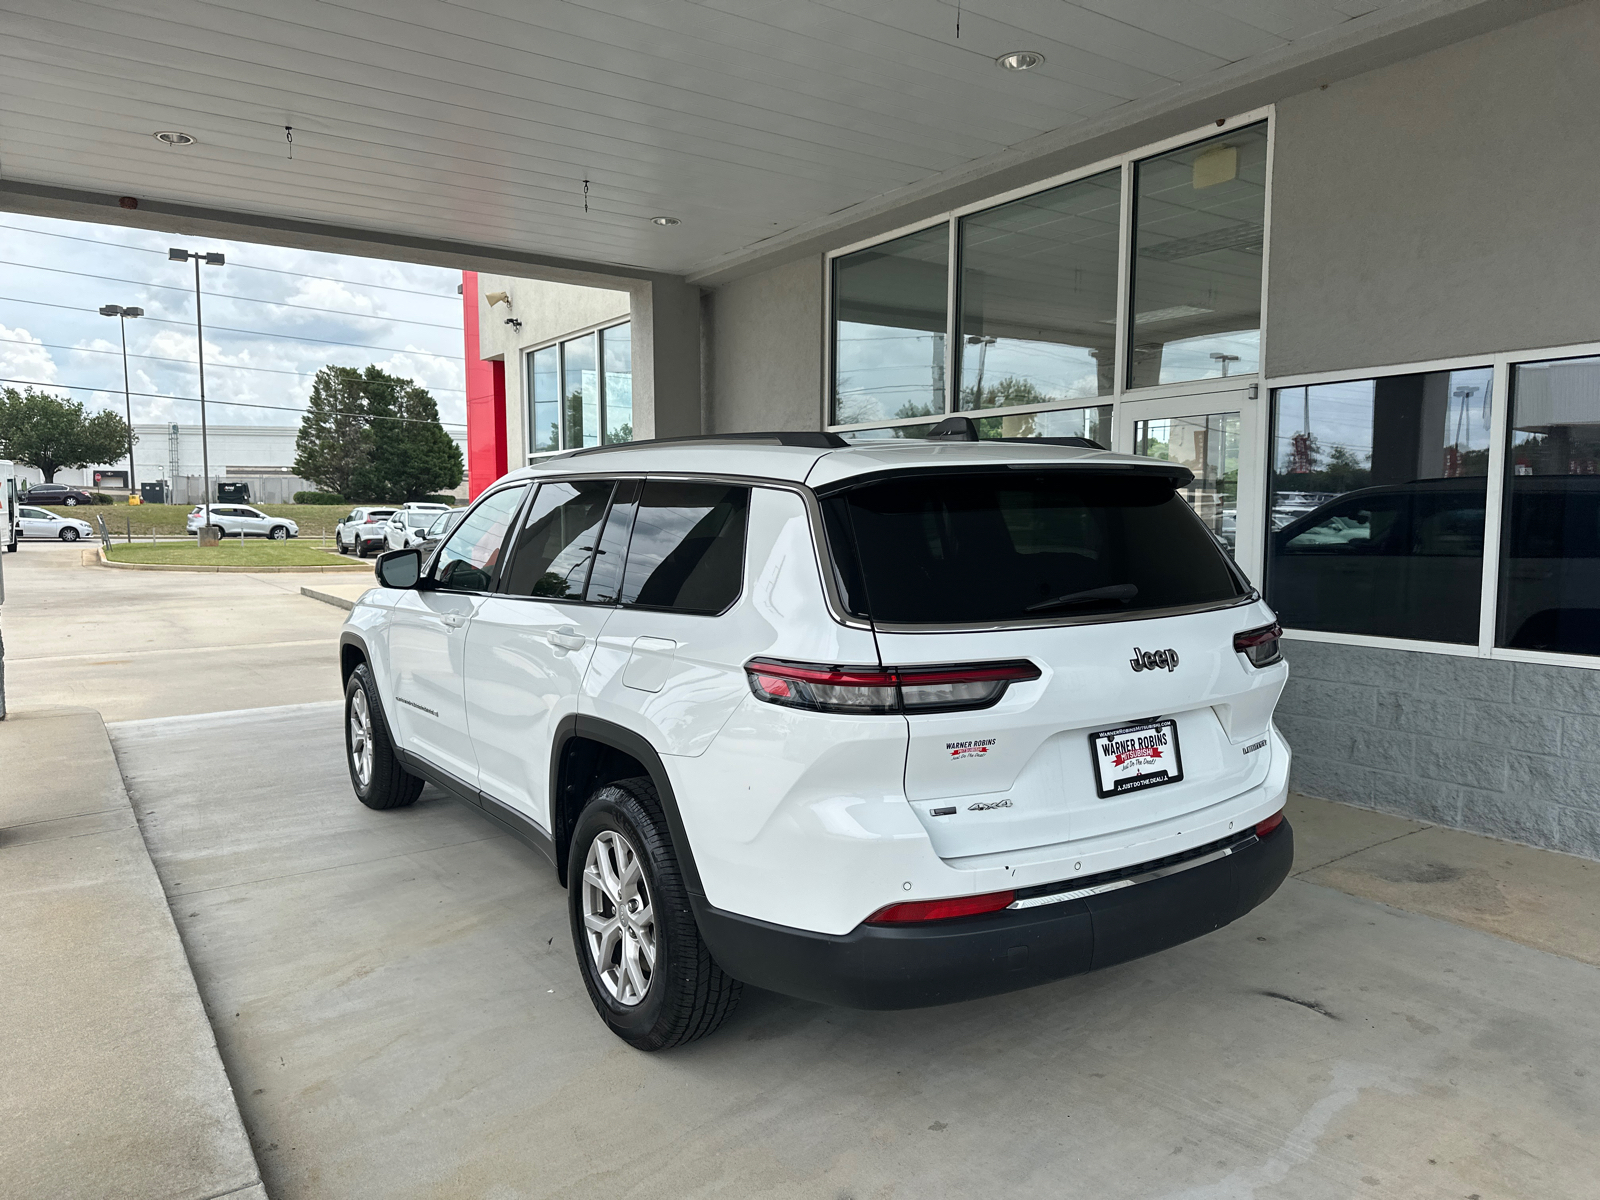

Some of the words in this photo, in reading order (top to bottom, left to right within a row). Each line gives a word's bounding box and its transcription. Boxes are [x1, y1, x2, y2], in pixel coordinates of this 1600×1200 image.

[1130, 646, 1179, 672] Jeep
[946, 742, 972, 750] WARNER
[973, 738, 996, 747] ROBINS
[1101, 739, 1136, 757] WARNER
[1138, 733, 1168, 748] ROBINS
[1121, 749, 1153, 761] MITSUBISHI
[1121, 783, 1133, 791] JUST
[1141, 779, 1150, 787] THE
[967, 799, 1013, 811] 4x4
